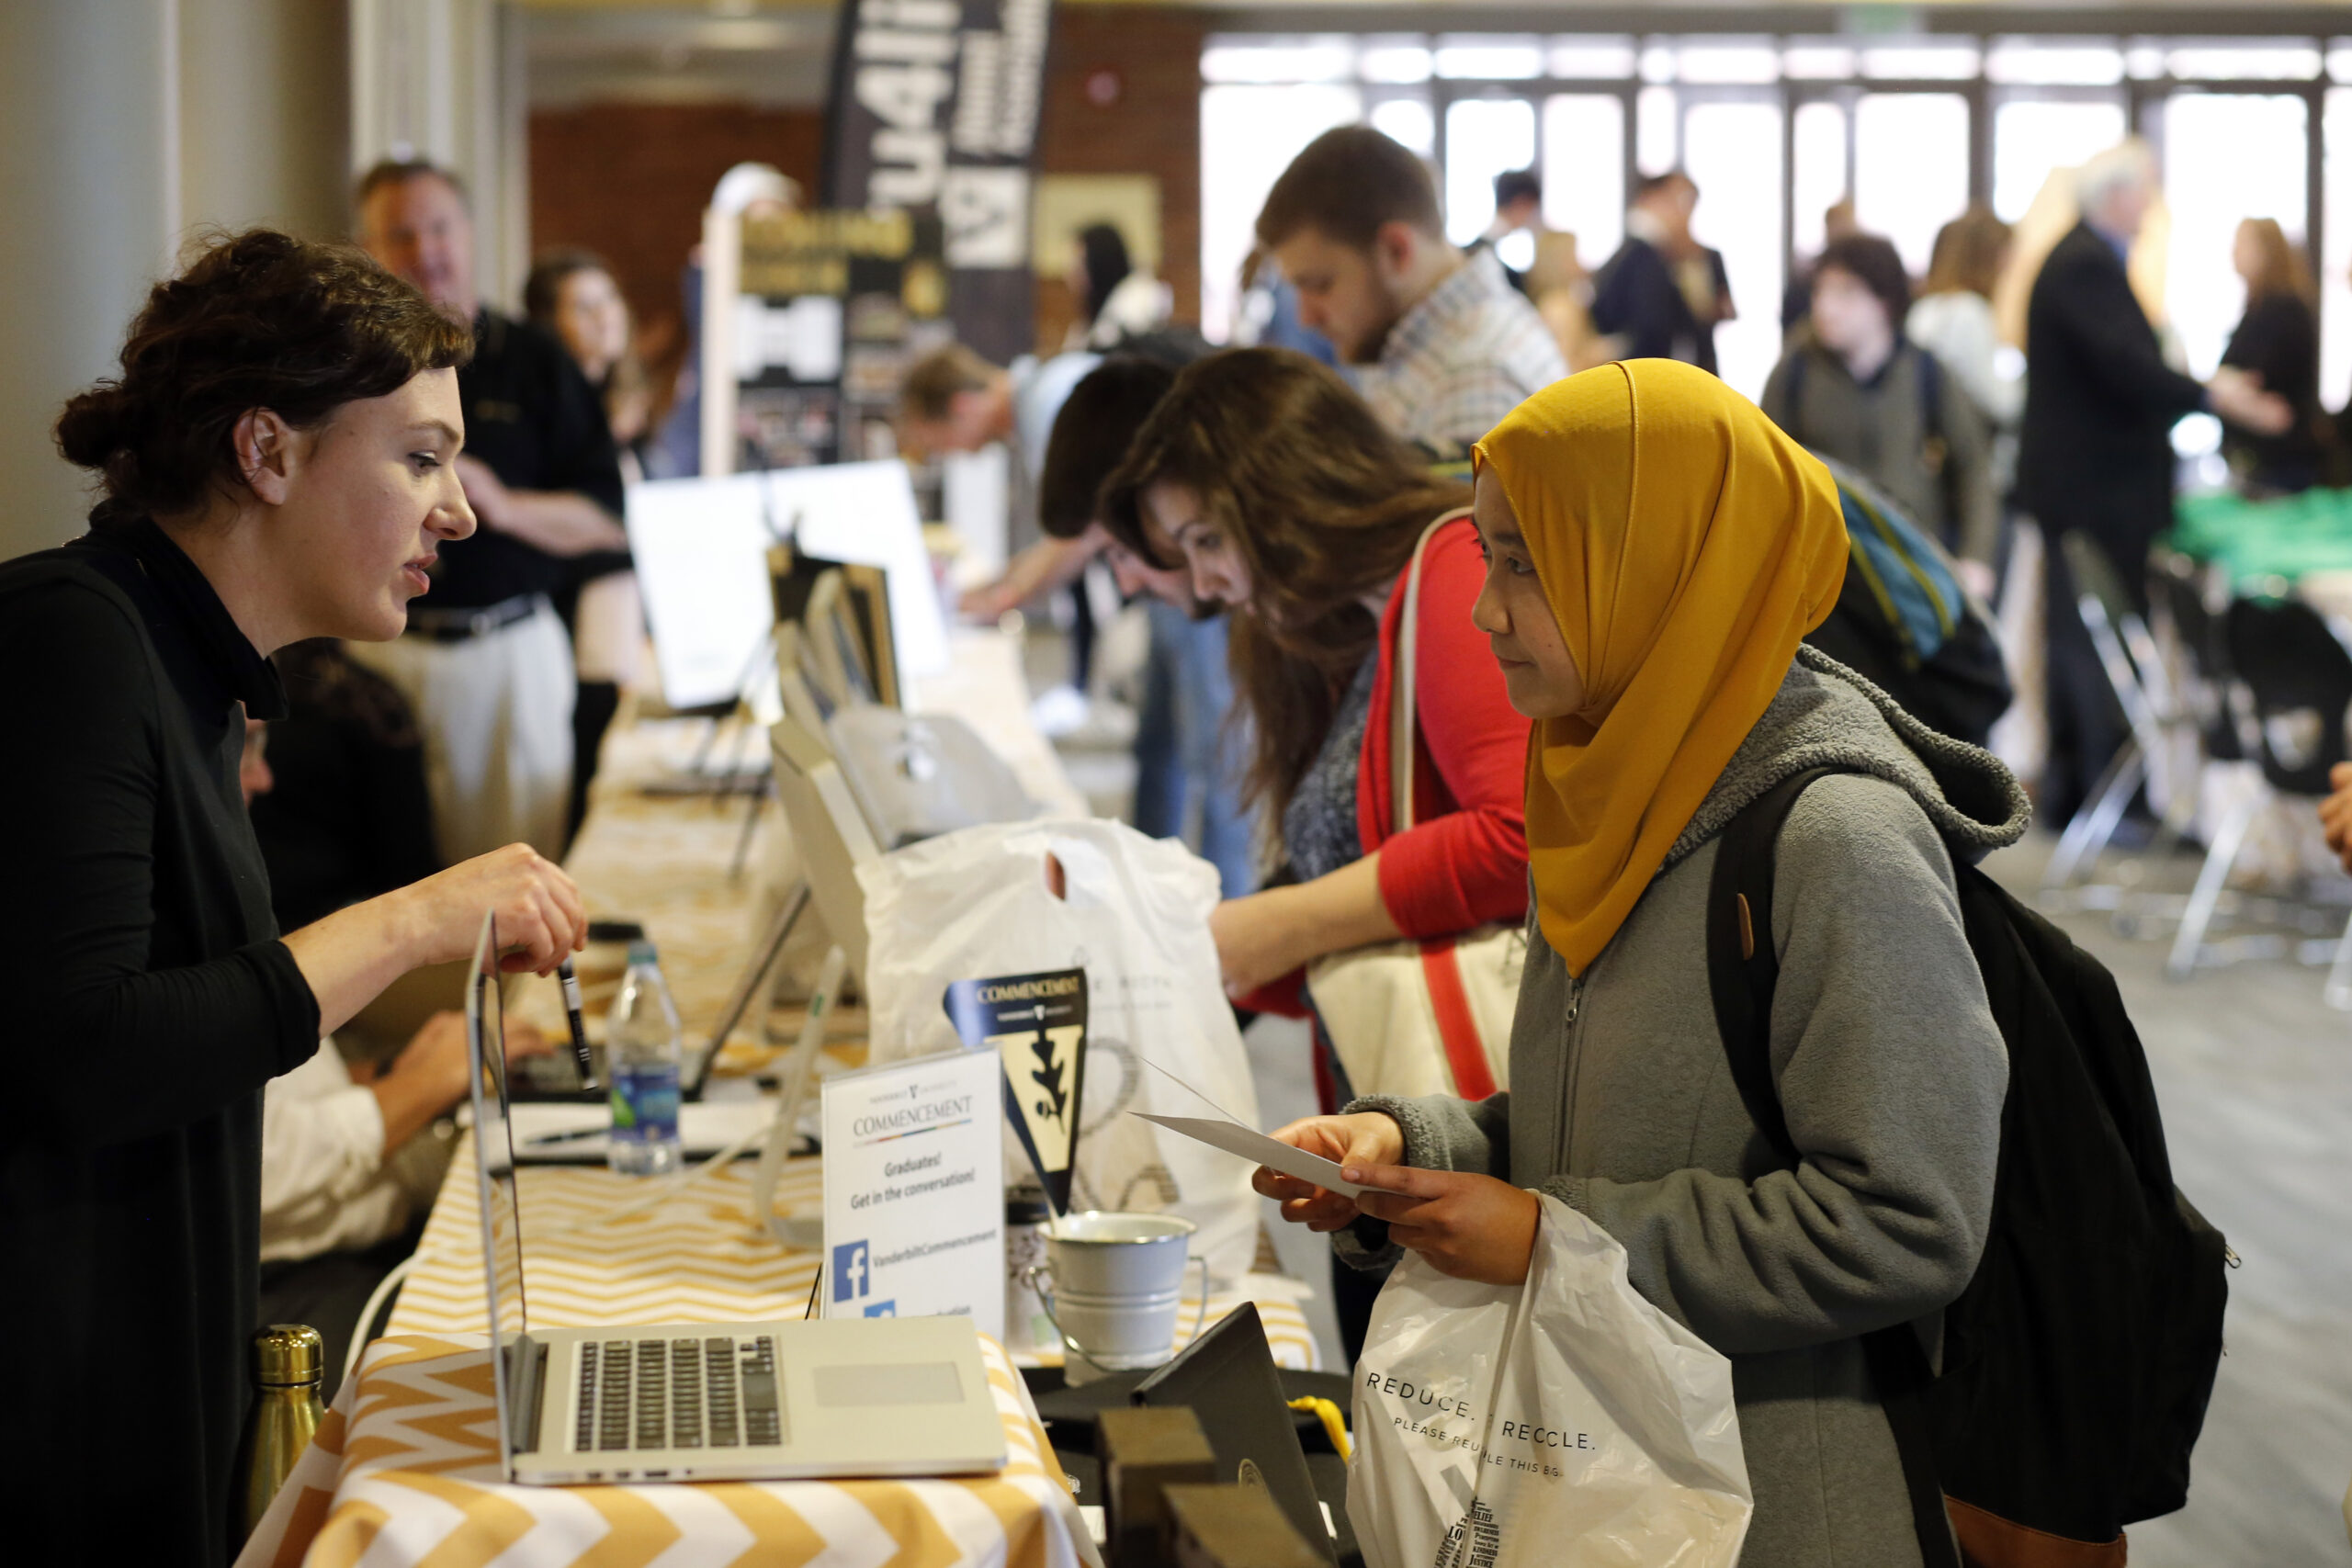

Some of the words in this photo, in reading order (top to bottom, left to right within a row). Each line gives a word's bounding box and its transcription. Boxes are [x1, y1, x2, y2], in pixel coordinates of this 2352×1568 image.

[853, 1095, 973, 1137] COMMENCEMENT
[885, 1152, 942, 1178] Graduates!
[851, 1194, 871, 1210] Get
[873, 1190, 883, 1204] in
[885, 1186, 901, 1201] the
[904, 1168, 976, 1197] conversation!
[1367, 1372, 1475, 1421] REDUCE.
[1394, 1417, 1446, 1440] PLEASE
[1510, 1458, 1538, 1473] THIS
